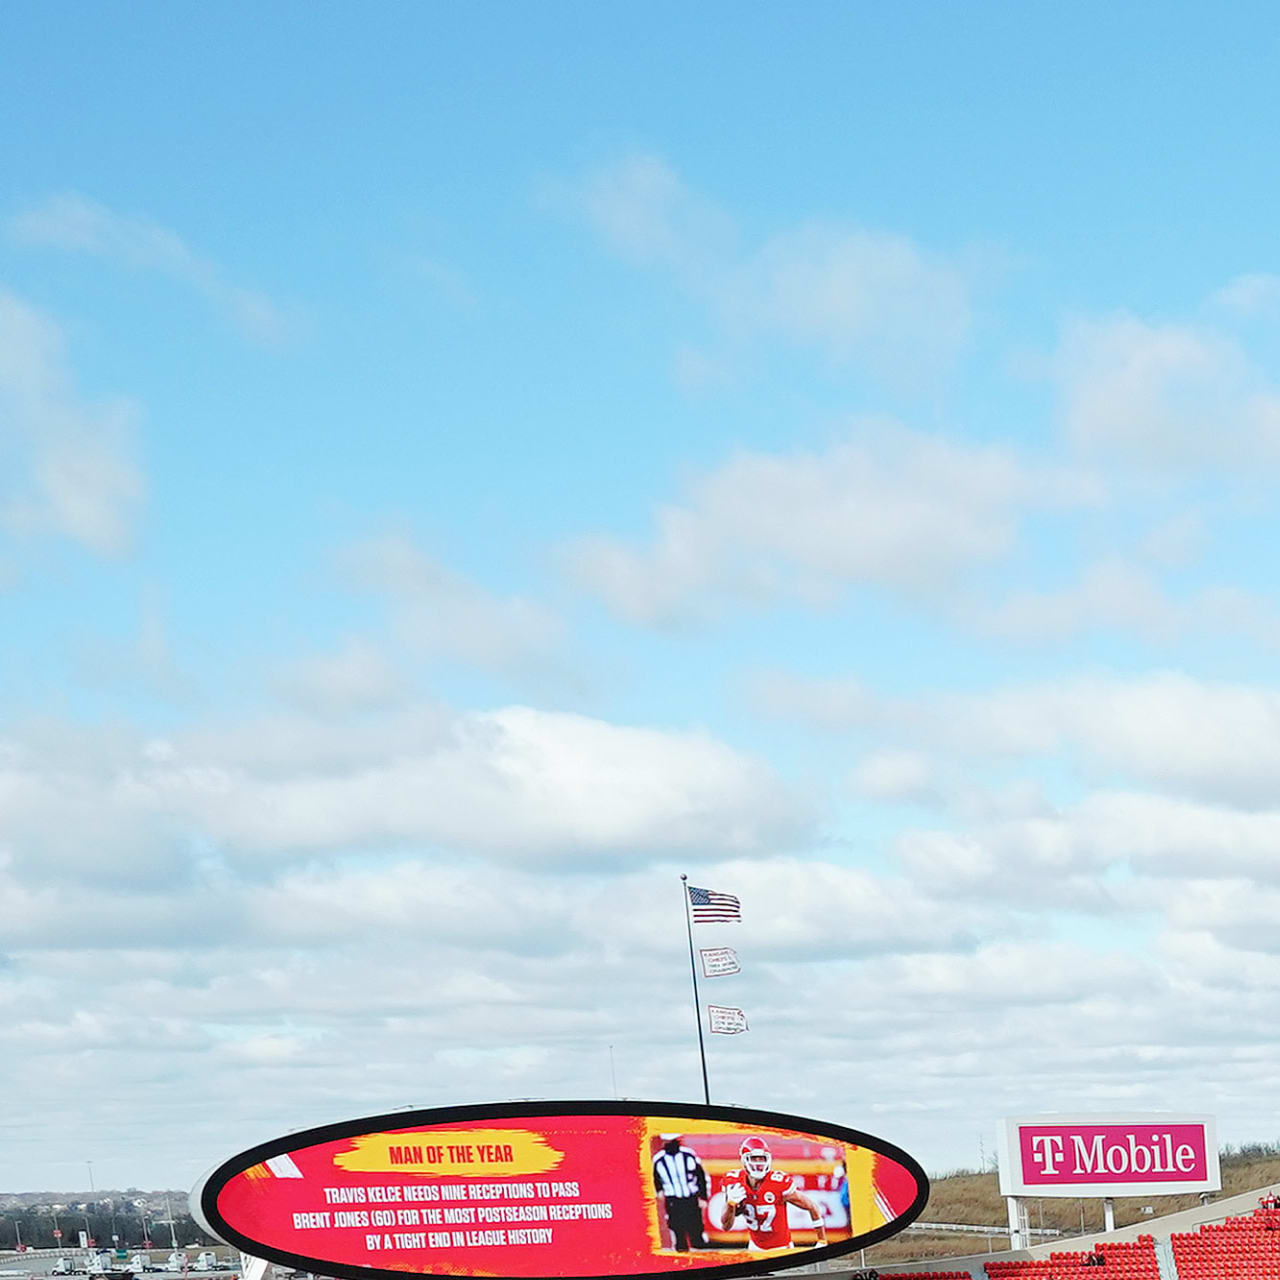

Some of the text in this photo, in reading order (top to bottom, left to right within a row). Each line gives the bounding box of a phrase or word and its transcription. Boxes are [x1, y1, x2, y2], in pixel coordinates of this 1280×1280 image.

[389, 1144, 513, 1165] MAN OF THE YEAR
[1069, 1134, 1196, 1174] Mobile
[324, 1181, 580, 1204] TRAVIS KELCE NEEDS NINE RECEPTIONS TO PASS
[293, 1203, 613, 1229] BRENT JONES (60) FOR THE MOST POSTSEASON RECEPTIONS
[366, 1228, 553, 1251] BY A TIGHT END IN LEAGUE HISTORY
